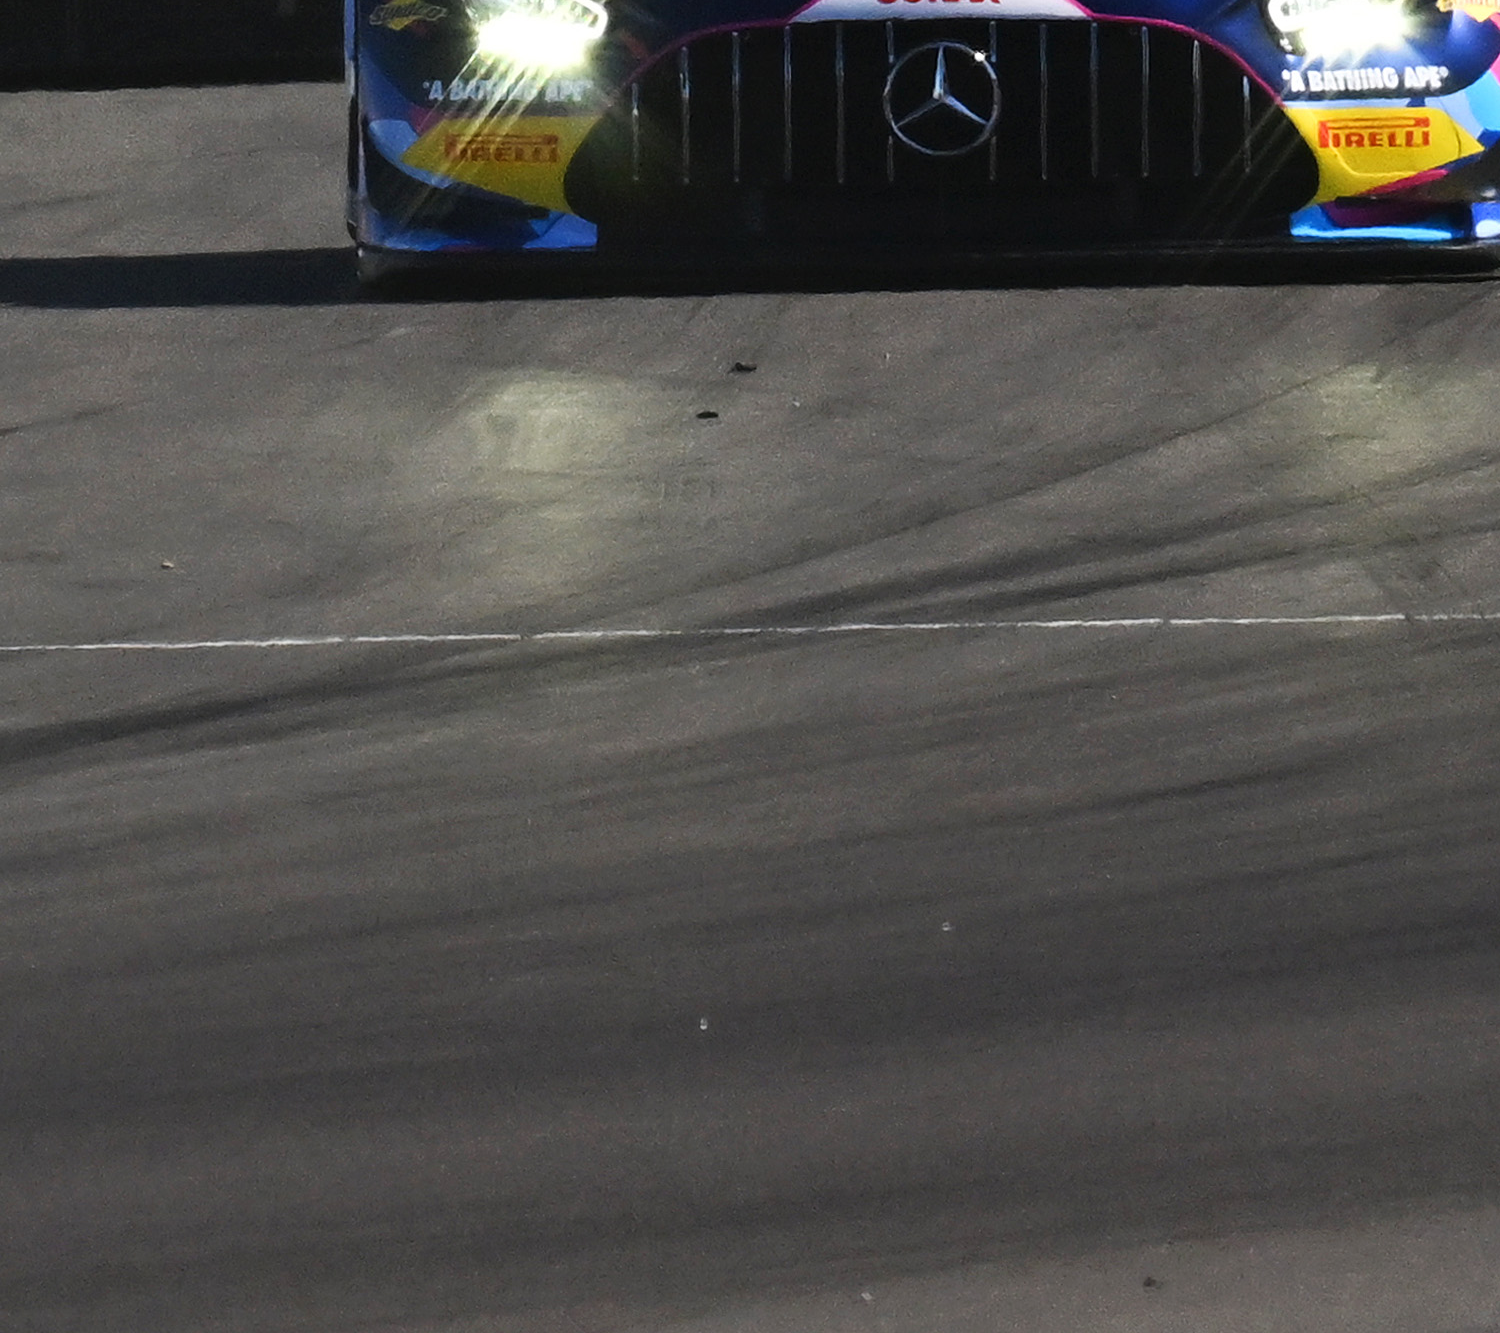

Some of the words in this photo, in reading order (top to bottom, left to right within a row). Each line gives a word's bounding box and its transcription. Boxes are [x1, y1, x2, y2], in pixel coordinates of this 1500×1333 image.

[1308, 67, 1399, 92] BATHING
[1318, 117, 1430, 148] PIRELLI
[444, 133, 559, 163] PIRELLI
